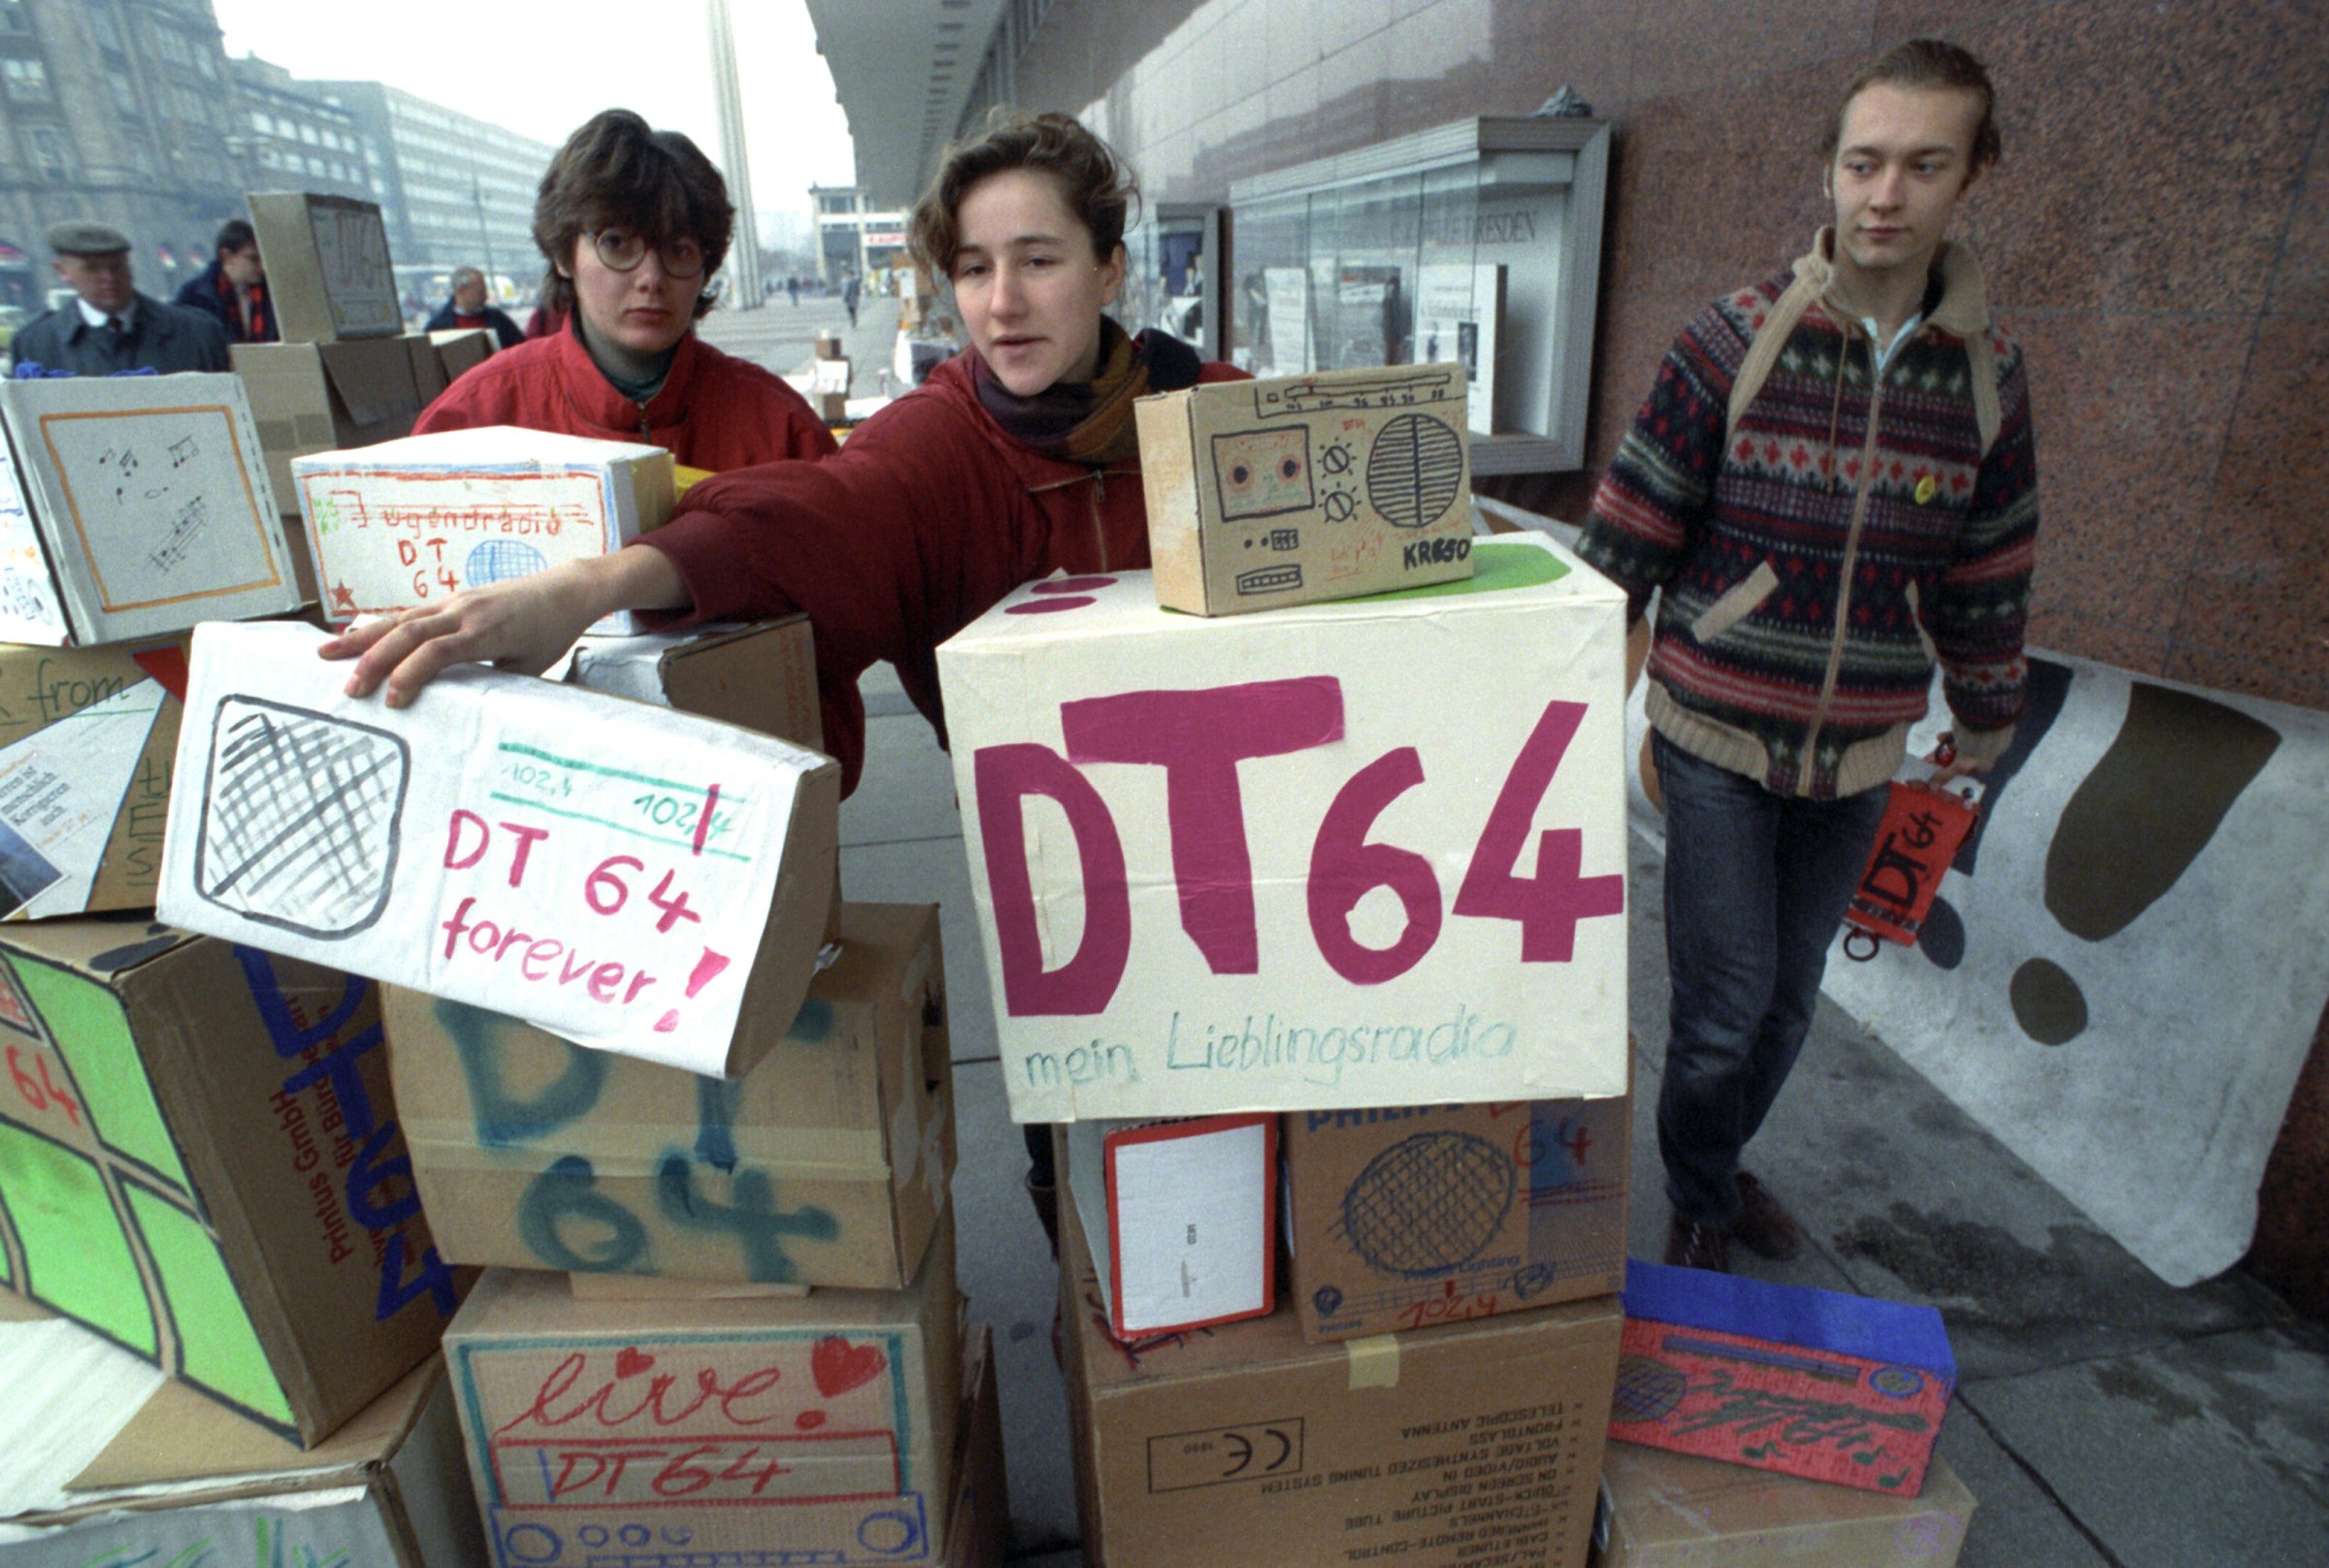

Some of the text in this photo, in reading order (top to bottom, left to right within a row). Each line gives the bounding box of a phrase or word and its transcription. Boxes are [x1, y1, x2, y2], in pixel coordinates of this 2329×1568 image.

[412, 566, 459, 598] 64
[26, 657, 130, 723] from
[974, 674, 1624, 1018] DT64
[1025, 1003, 1518, 1090] mein Lieblingsradio
[5, 1044, 81, 1126] 64
[268, 1088, 354, 1264] Printus GmbH
[517, 1147, 840, 1284] 64
[1401, 1402, 1563, 1440] TELESCOPIC ANTENNA
[1262, 1436, 1559, 1494] VOLTAGE SYNTHESIZED TUNING SYSTEM
[1442, 1453, 1558, 1483] AUDIO/VIDEO IN
[1479, 1473, 1534, 1493] SCREEN
[1412, 1482, 1473, 1503] DISPLAY
[1344, 1514, 1384, 1531] TUBE
[1392, 1502, 1454, 1523] PICTURE
[1345, 1529, 1475, 1561] REMOTE-CONTROL
